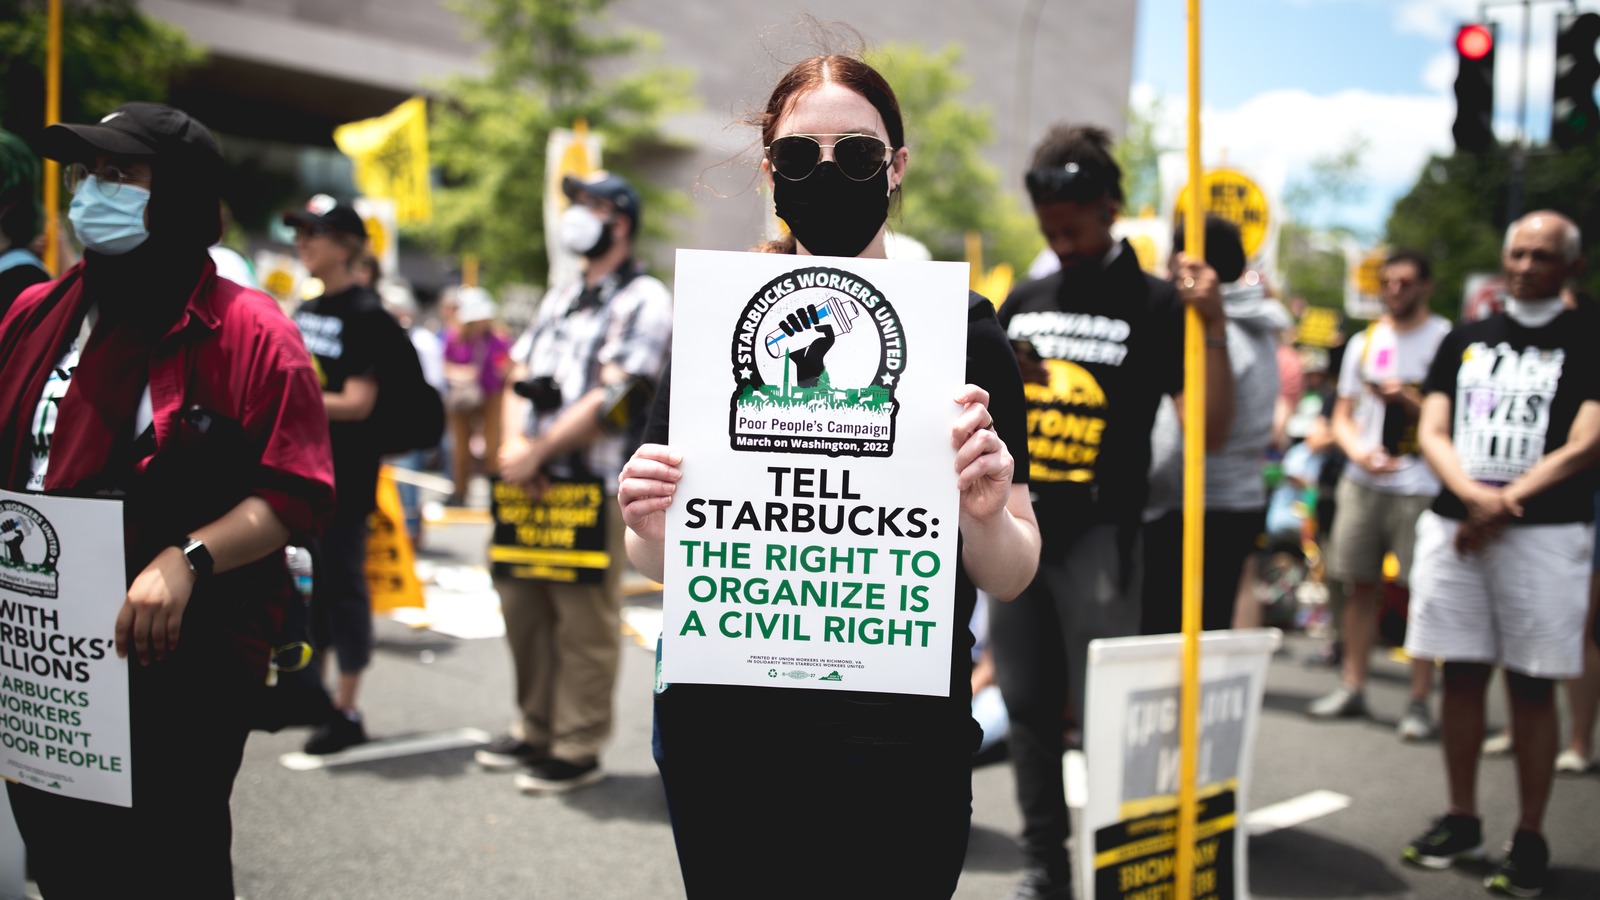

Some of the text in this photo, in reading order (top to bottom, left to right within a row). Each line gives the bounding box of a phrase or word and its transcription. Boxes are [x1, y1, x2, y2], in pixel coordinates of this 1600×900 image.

[737, 272, 902, 371] STARBUCKS WORKERS UNITED
[736, 436, 889, 453] March on Washington, 2022
[738, 416, 889, 438] Poor People's Campaign
[767, 466, 861, 500] TELL
[684, 498, 940, 539] STARBUCKS:
[679, 540, 941, 578] THE RIGHT TO
[688, 575, 930, 613] ORGANIZE IS
[0, 599, 58, 630] WITH
[679, 610, 937, 648] A CIVIL RIGHT
[0, 674, 89, 708] ARBUCKS
[0, 731, 40, 757] OOR
[45, 745, 122, 772] PEOPLE
